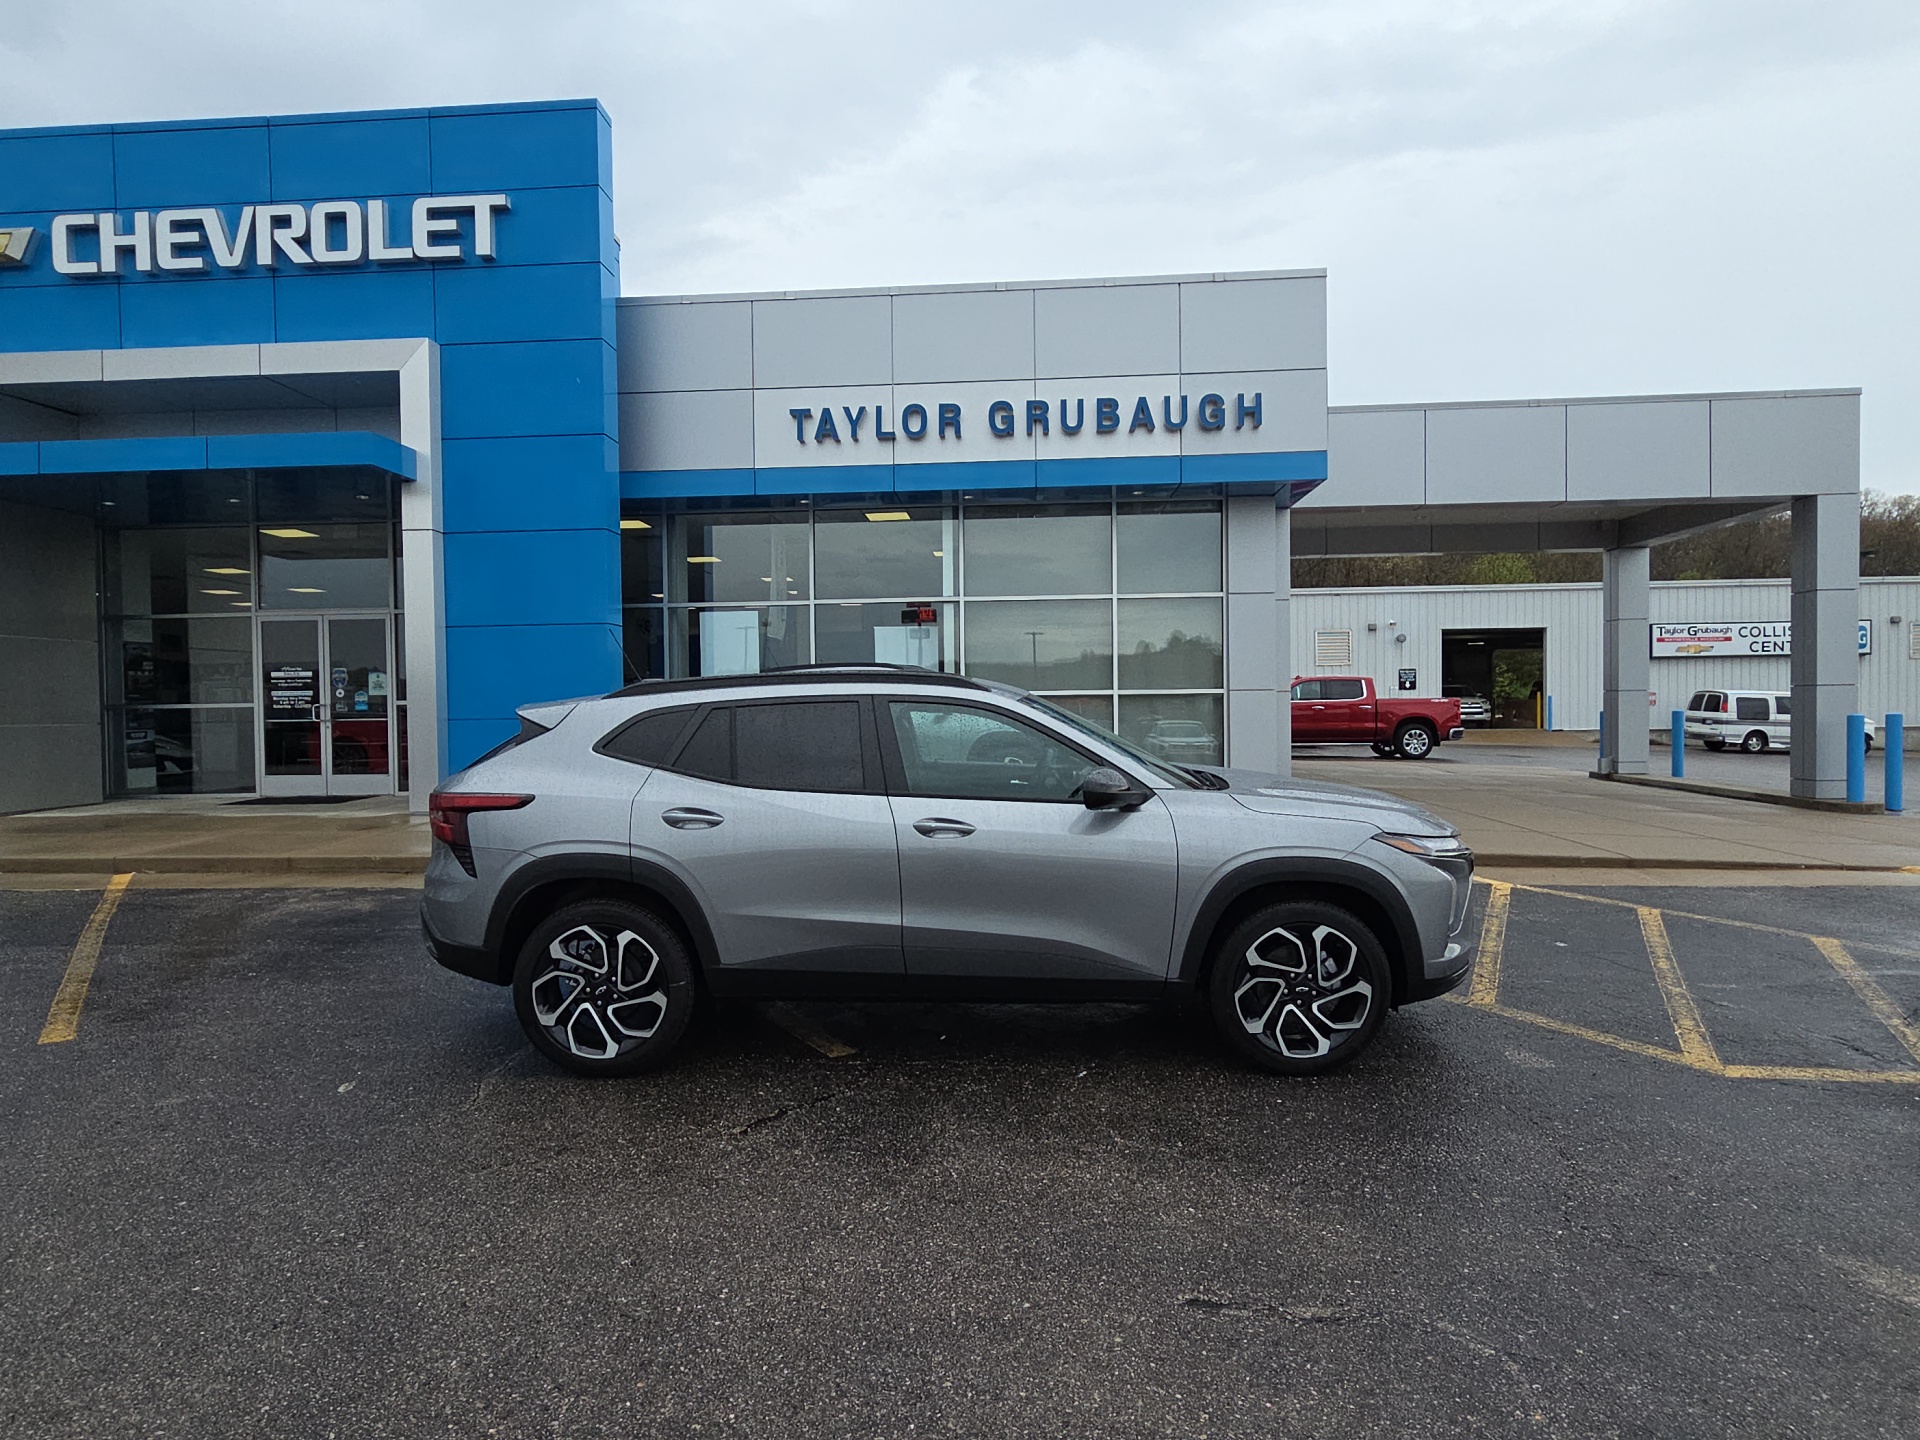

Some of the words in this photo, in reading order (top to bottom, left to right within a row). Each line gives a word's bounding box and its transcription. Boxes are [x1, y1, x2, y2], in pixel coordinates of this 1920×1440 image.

[51, 194, 511, 277] CHEVROLET
[789, 402, 962, 444] TAYLOR
[987, 392, 1264, 438] GRUBAUGH
[1656, 626, 1686, 637] Taylor
[1687, 626, 1732, 637] Grubaugh
